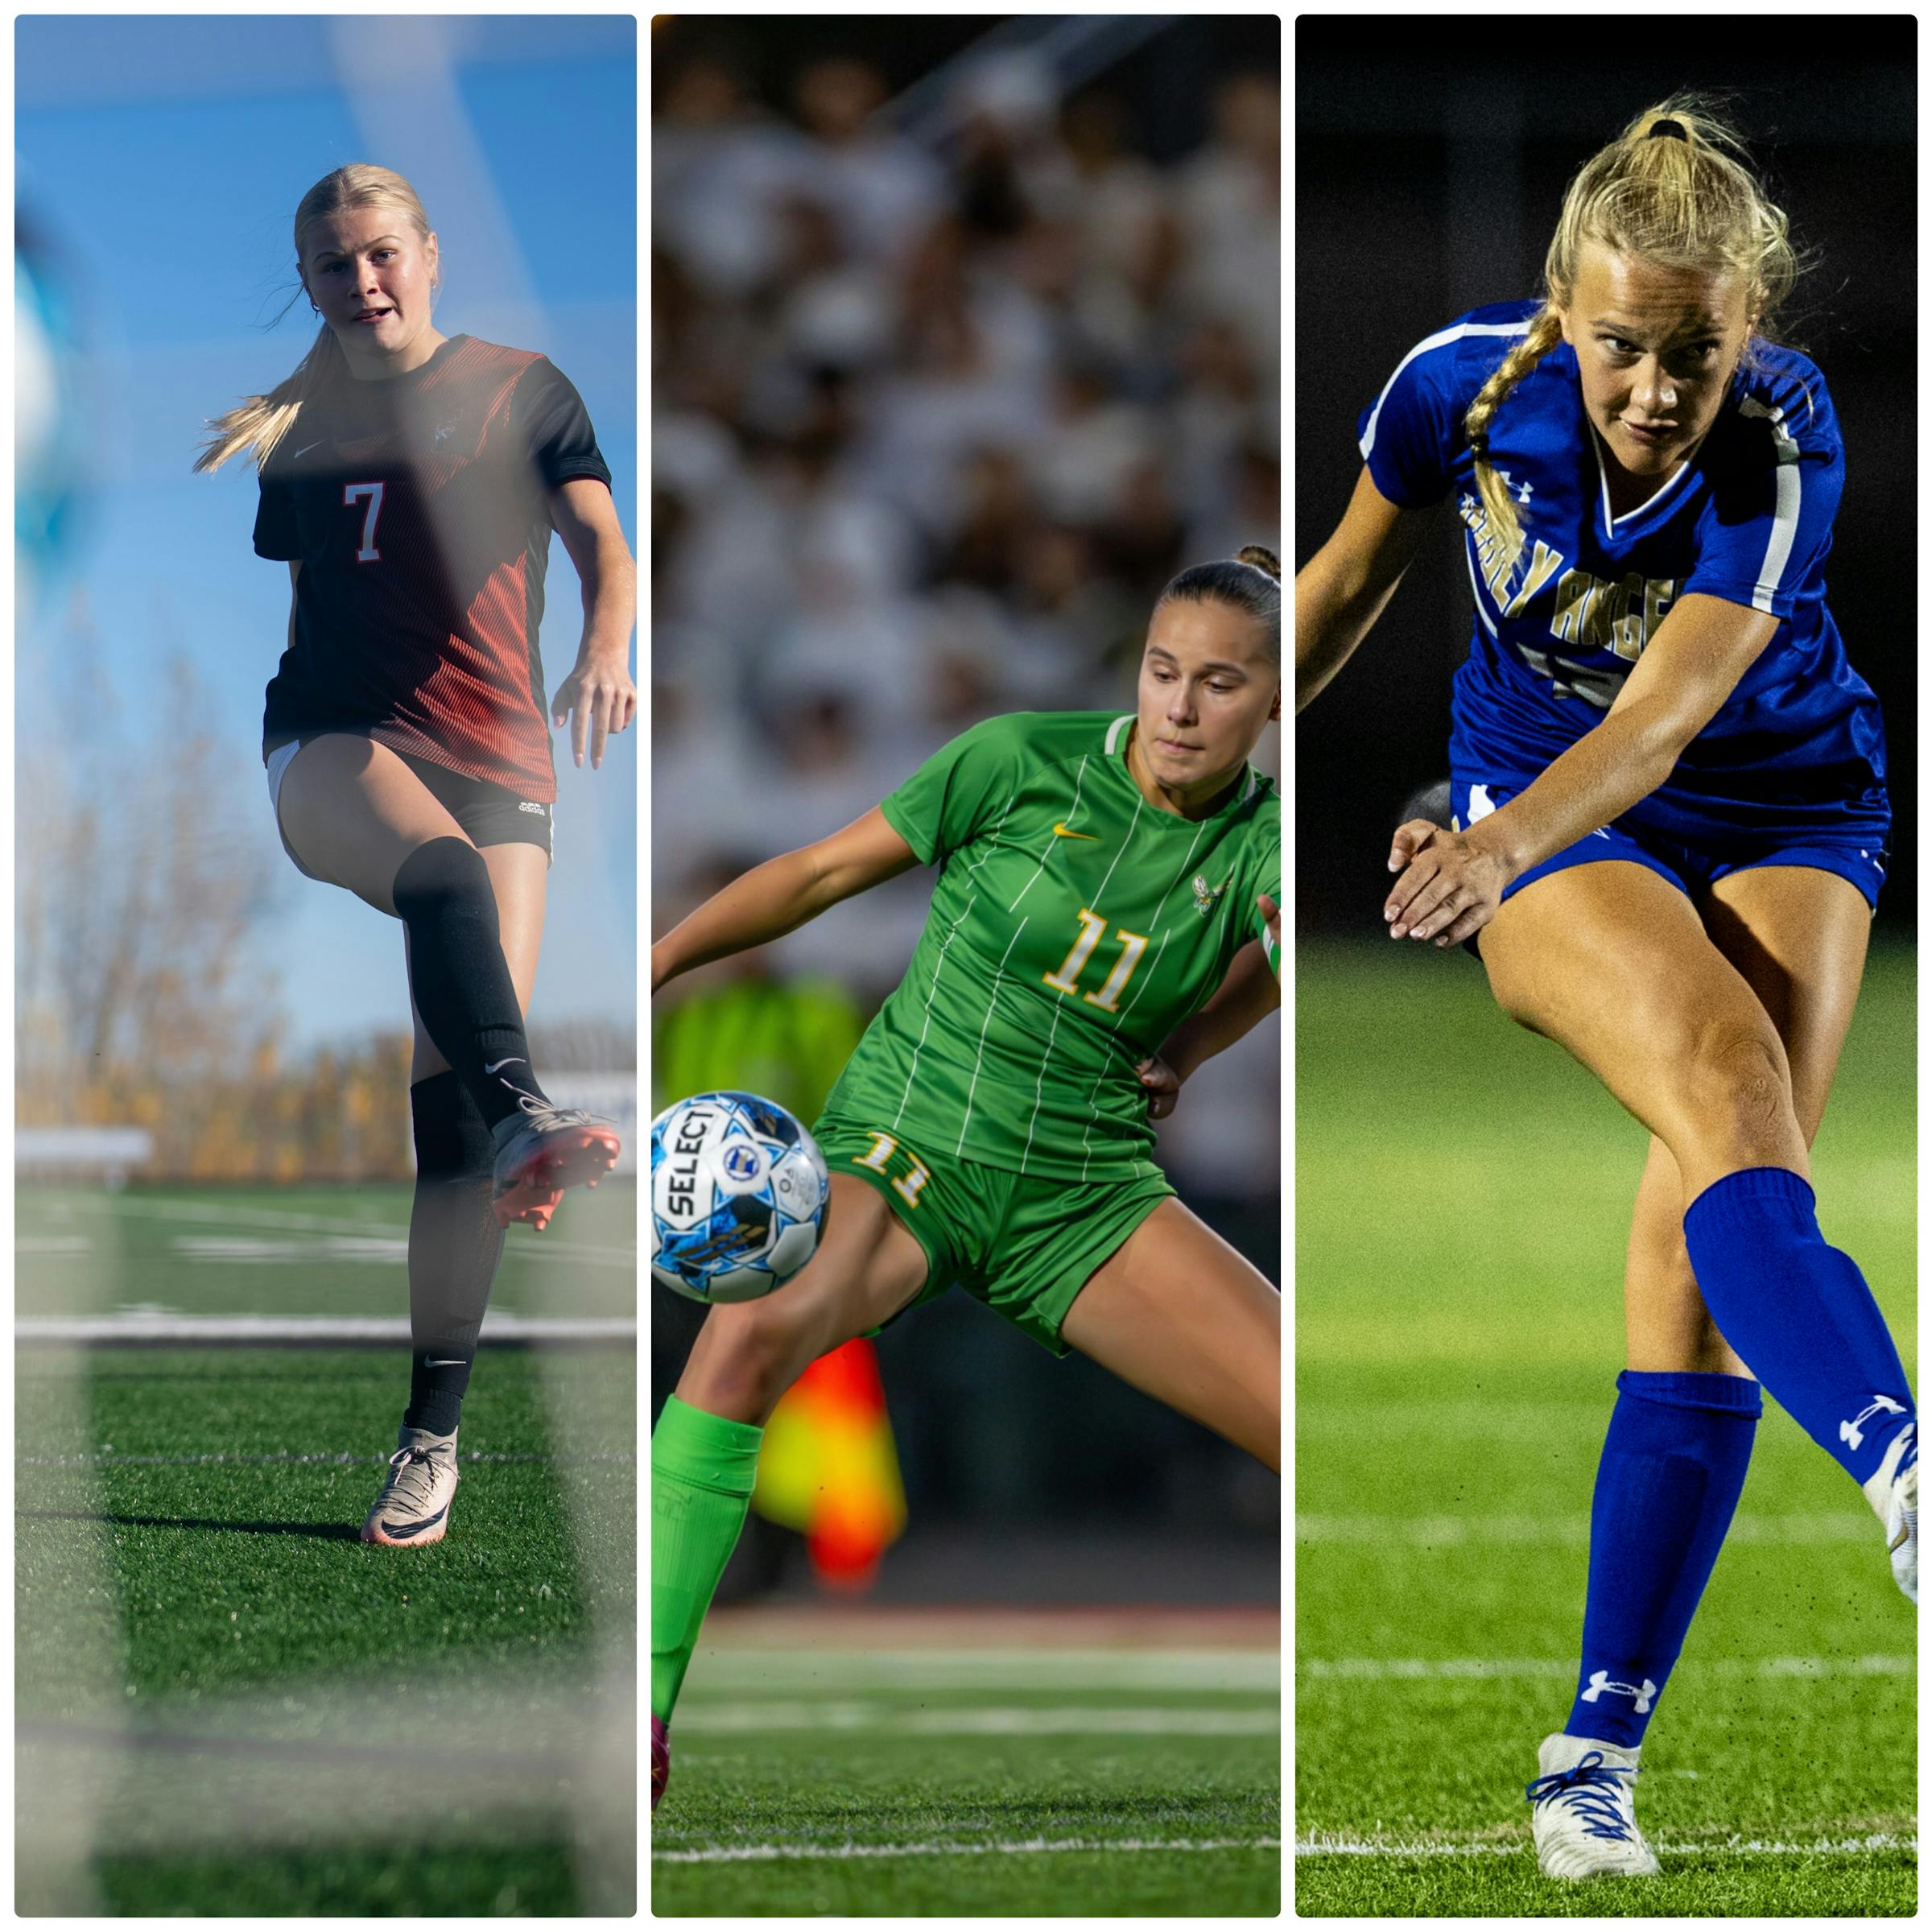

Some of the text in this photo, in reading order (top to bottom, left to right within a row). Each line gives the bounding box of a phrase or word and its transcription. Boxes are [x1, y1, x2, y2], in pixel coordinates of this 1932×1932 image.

[343, 481, 386, 564] 7
[1550, 567, 1687, 663] ANGE
[518, 804, 546, 816] adidas
[1042, 907, 1149, 1014] 11
[668, 1110, 713, 1216] SELECT
[852, 1130, 931, 1209] 11
